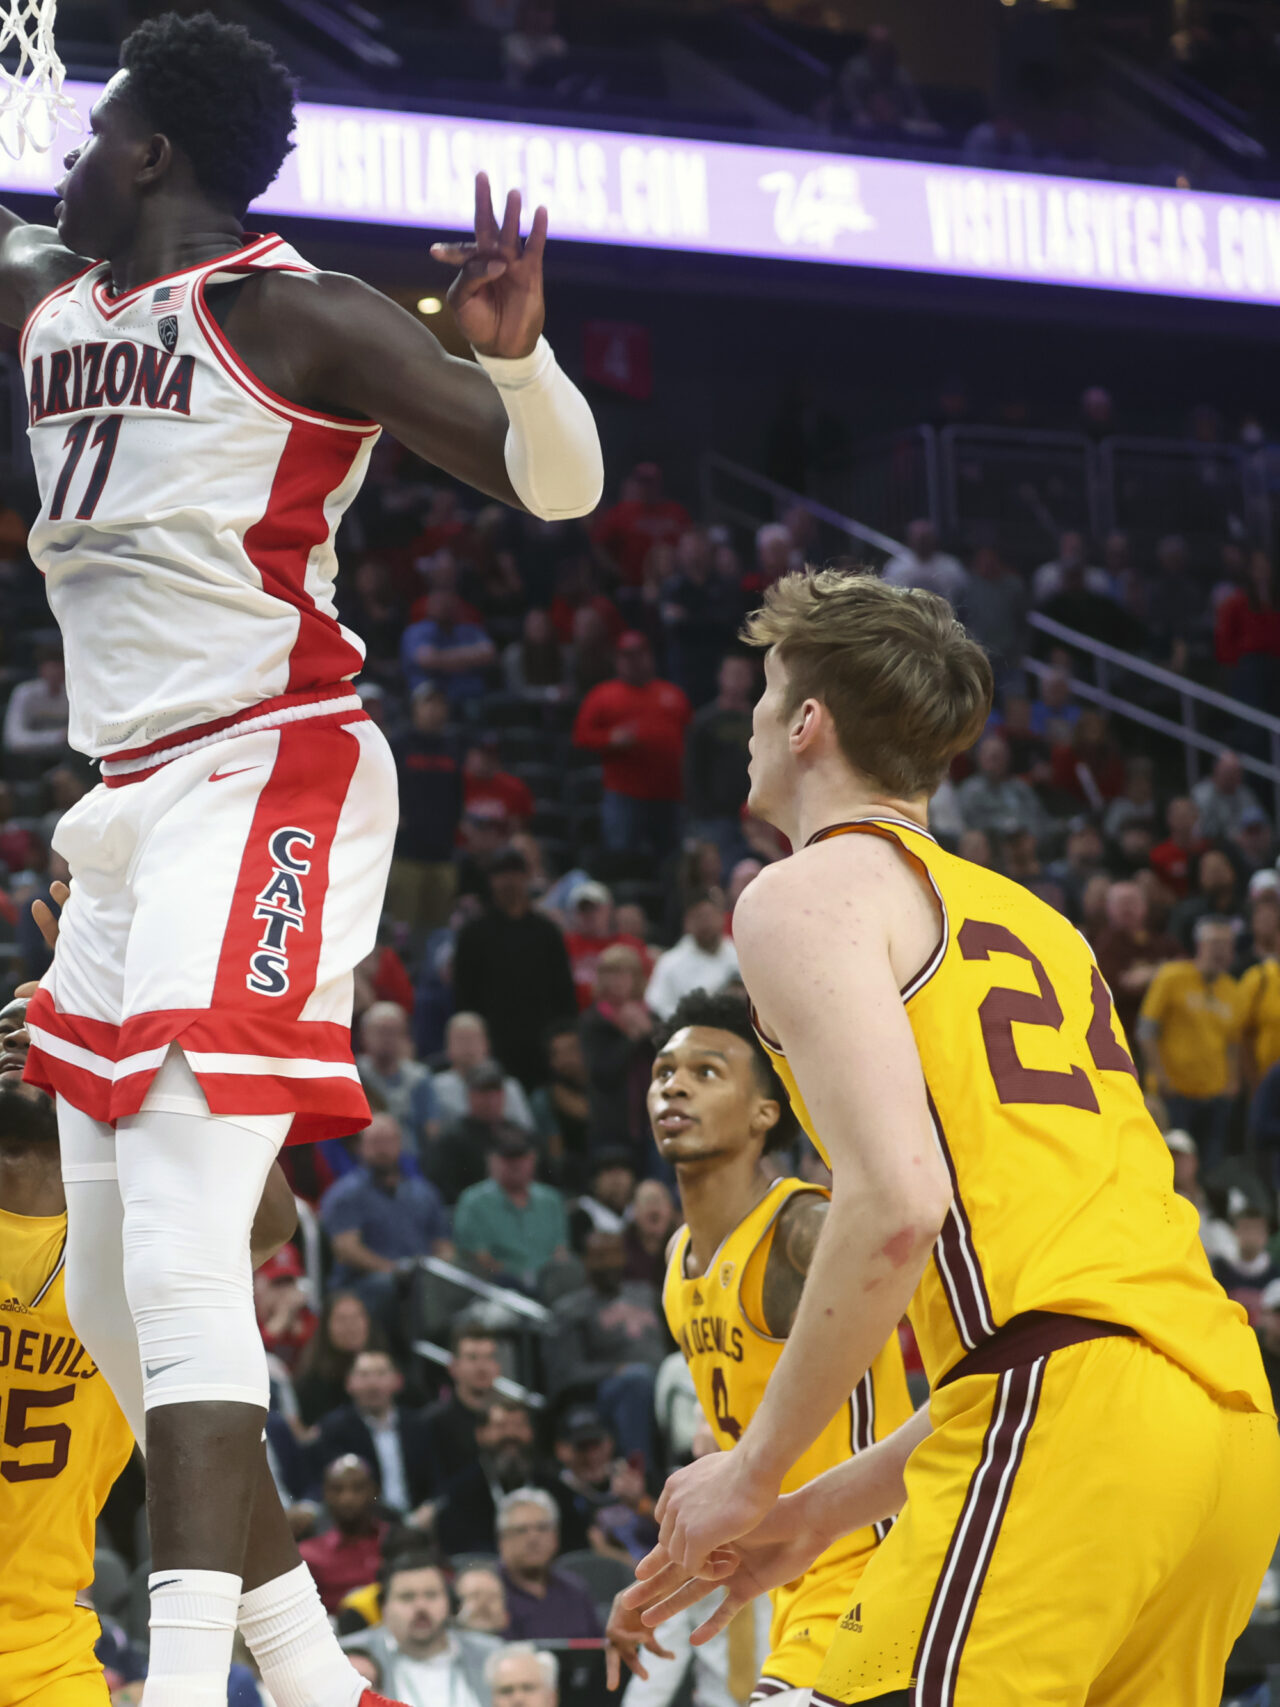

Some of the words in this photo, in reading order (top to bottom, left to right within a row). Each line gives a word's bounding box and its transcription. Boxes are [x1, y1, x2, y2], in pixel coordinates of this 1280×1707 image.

[30, 341, 196, 427] ARIZONA
[49, 414, 124, 520] 11
[246, 826, 315, 997] CATS
